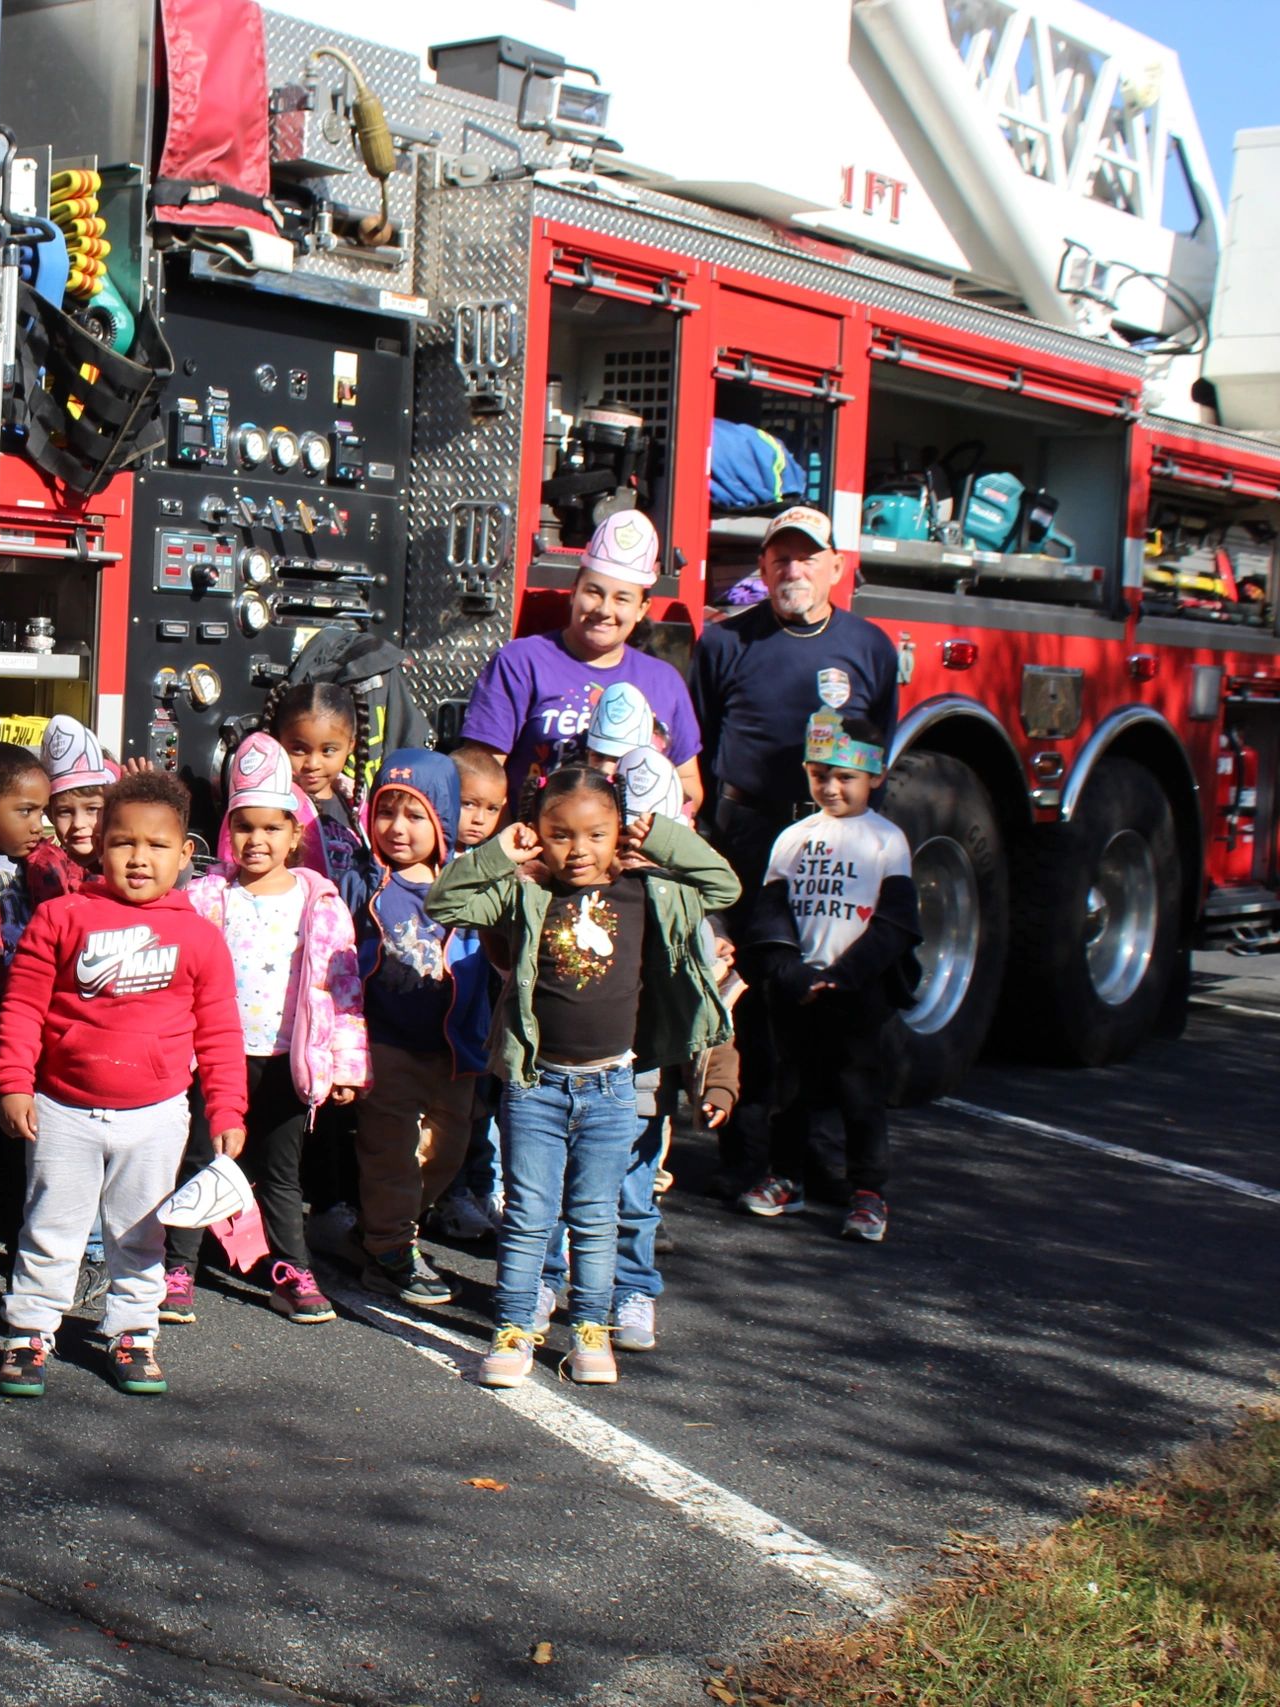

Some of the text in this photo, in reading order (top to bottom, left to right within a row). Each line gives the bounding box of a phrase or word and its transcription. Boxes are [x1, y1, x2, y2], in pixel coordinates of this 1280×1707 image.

[796, 859, 858, 879] STEAL
[793, 879, 845, 897] YOUR
[791, 899, 857, 921] HEART
[83, 925, 152, 961] JUMP
[118, 945, 180, 979] MAN
